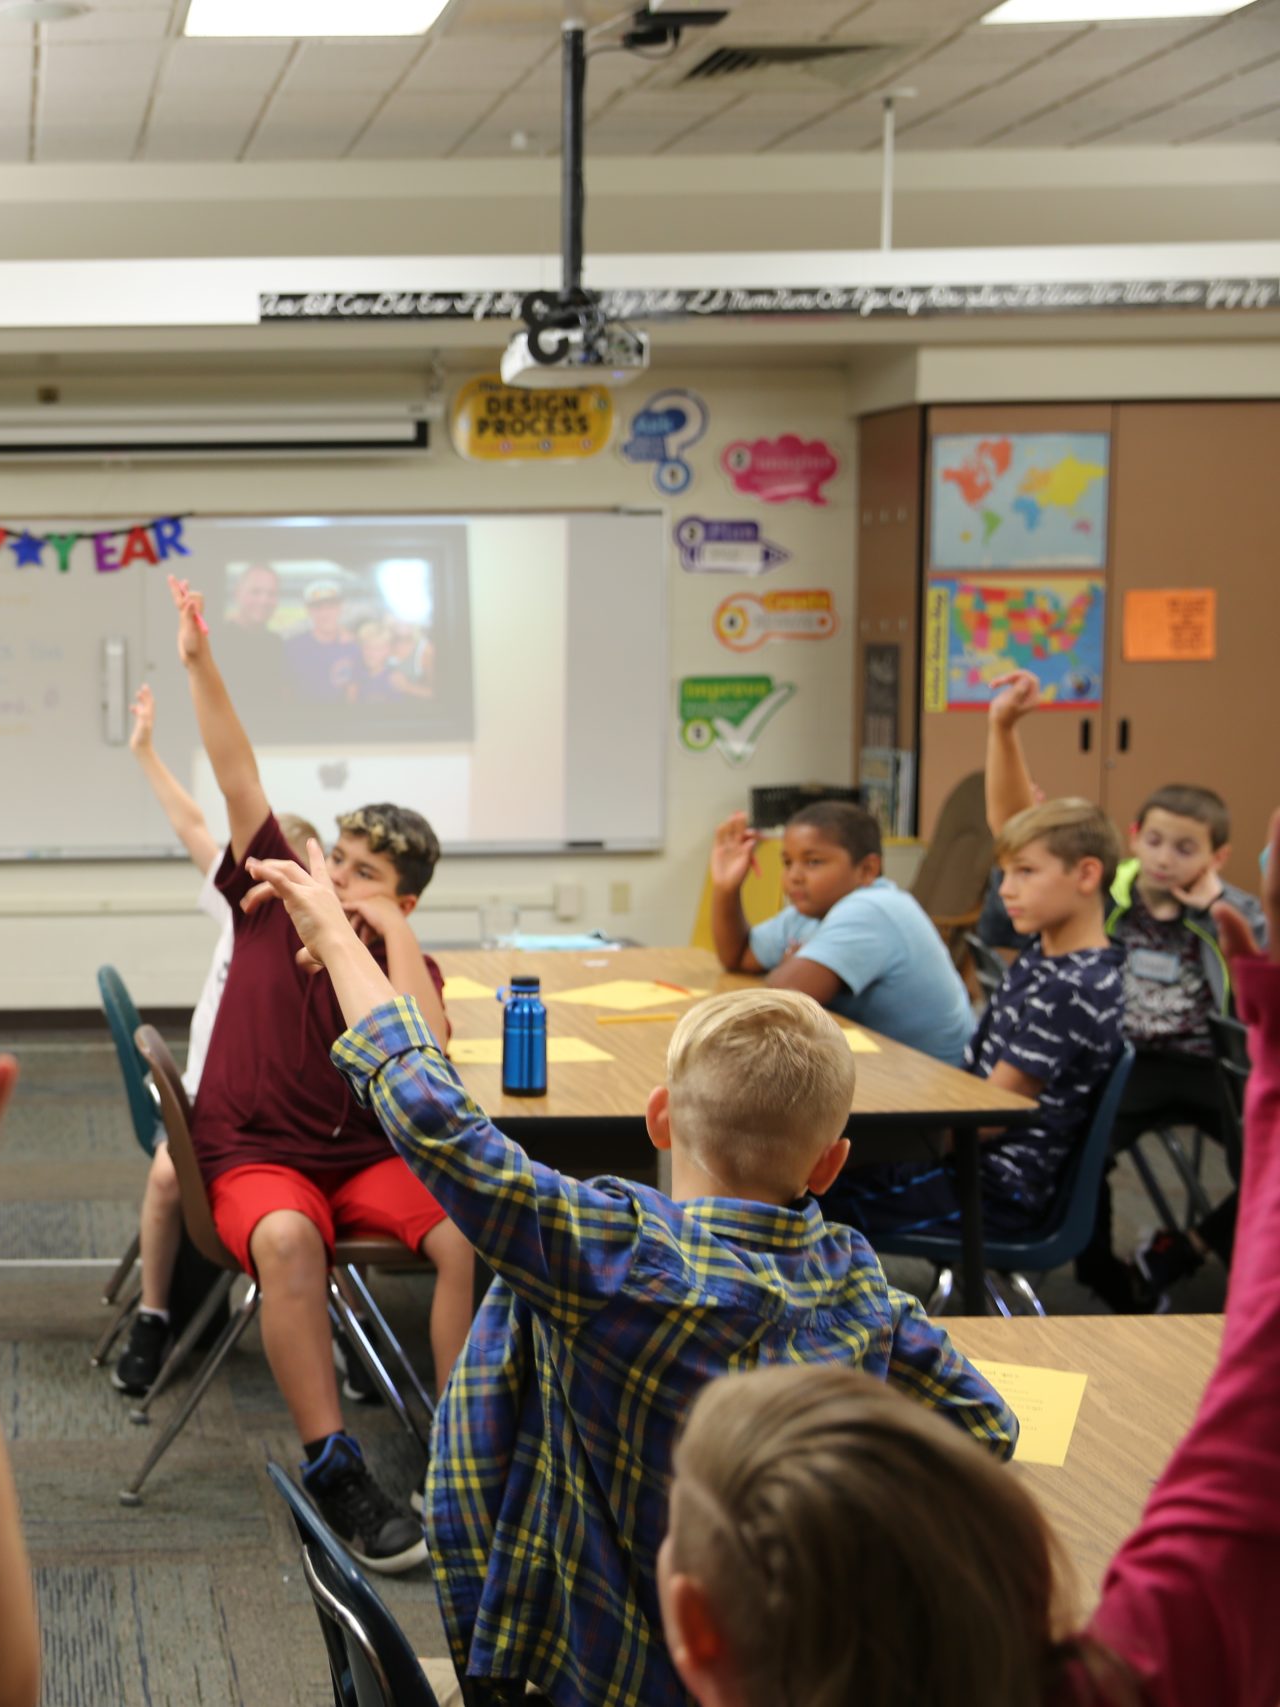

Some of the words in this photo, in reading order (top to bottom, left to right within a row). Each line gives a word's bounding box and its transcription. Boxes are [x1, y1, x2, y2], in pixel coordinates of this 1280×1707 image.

[485, 395, 580, 416] DESIGN
[477, 415, 590, 438] PROCESS
[45, 517, 191, 573] YEAR
